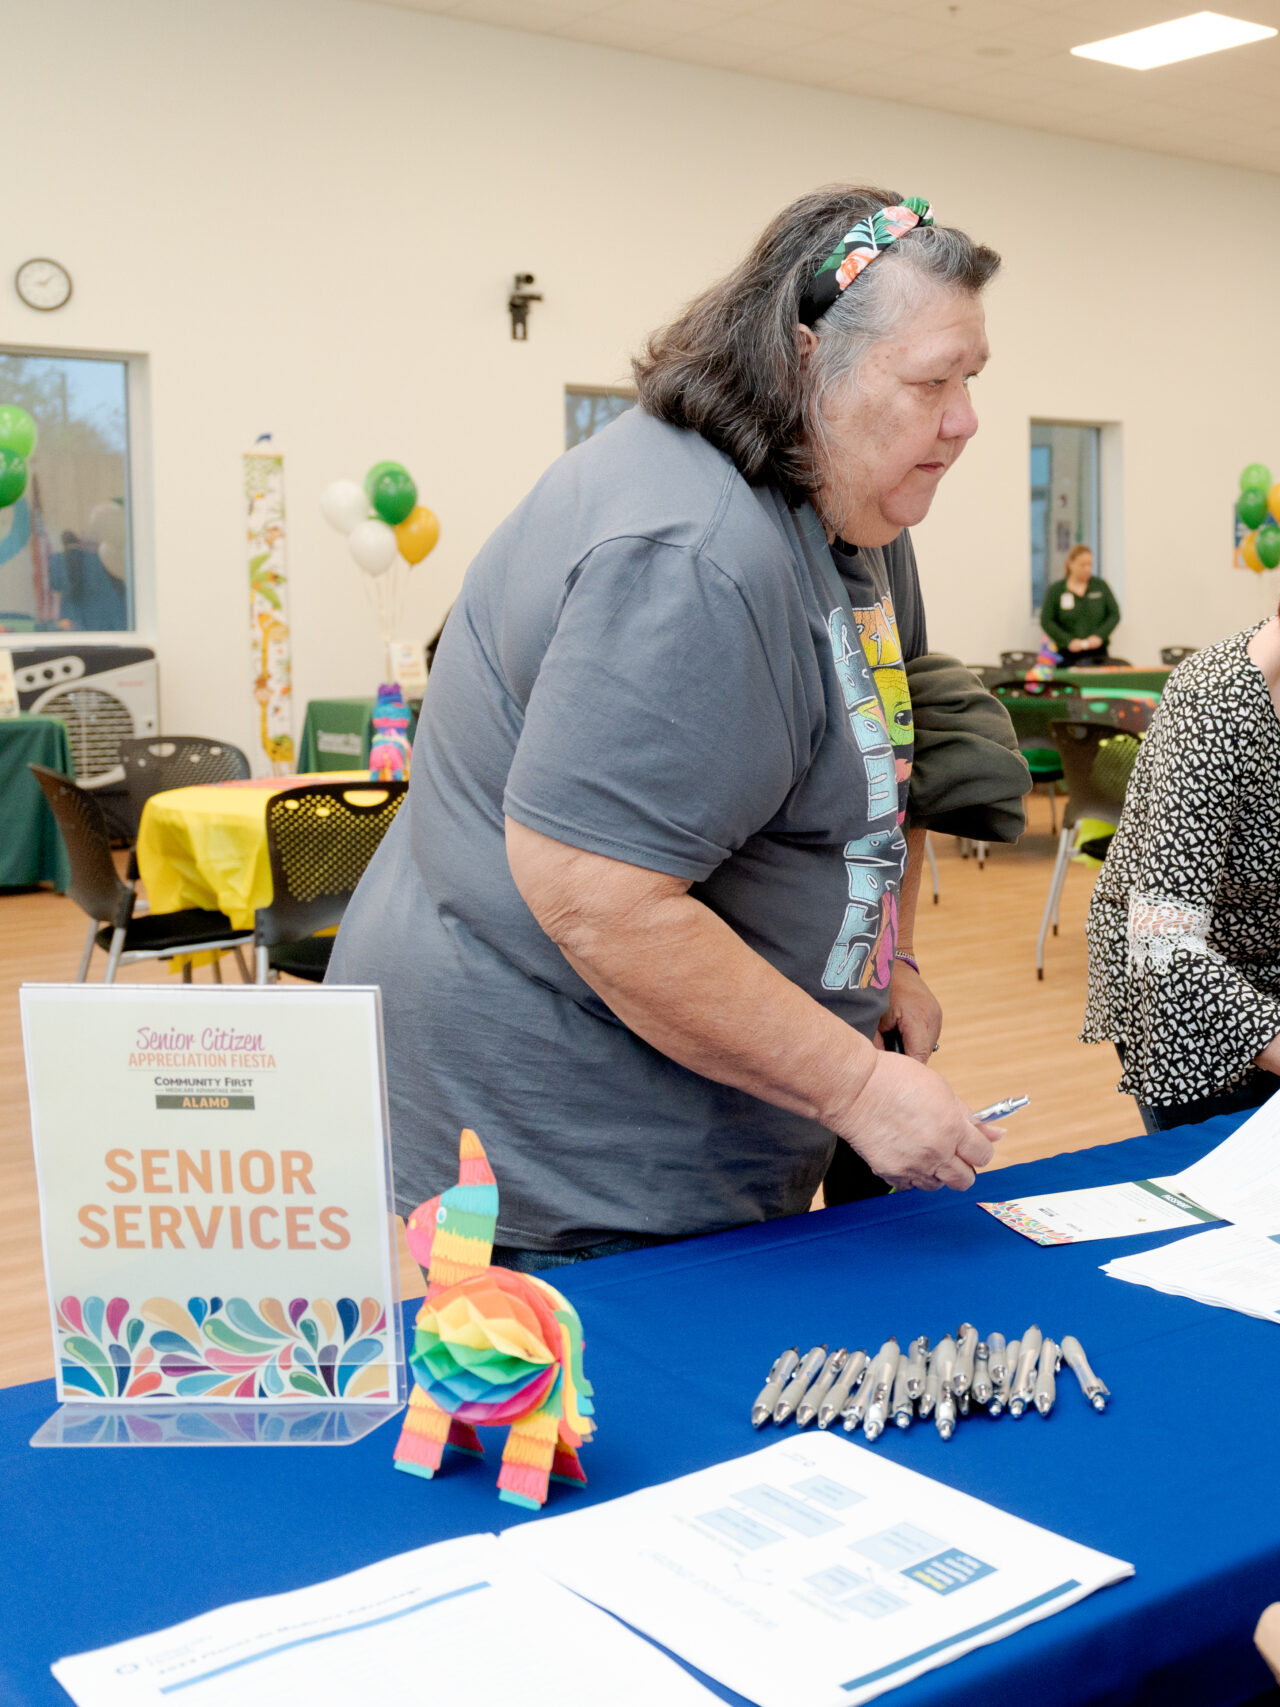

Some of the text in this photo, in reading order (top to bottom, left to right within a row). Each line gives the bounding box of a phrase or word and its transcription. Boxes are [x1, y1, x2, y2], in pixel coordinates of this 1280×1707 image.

[821, 826, 907, 991] STAR
[136, 1026, 264, 1051] Senior Citizen
[128, 1052, 277, 1069] APPRECIATION FIESTA
[182, 1096, 230, 1109] ALAMO
[104, 1148, 316, 1195] SENIOR
[77, 1204, 352, 1251] SERVICES
